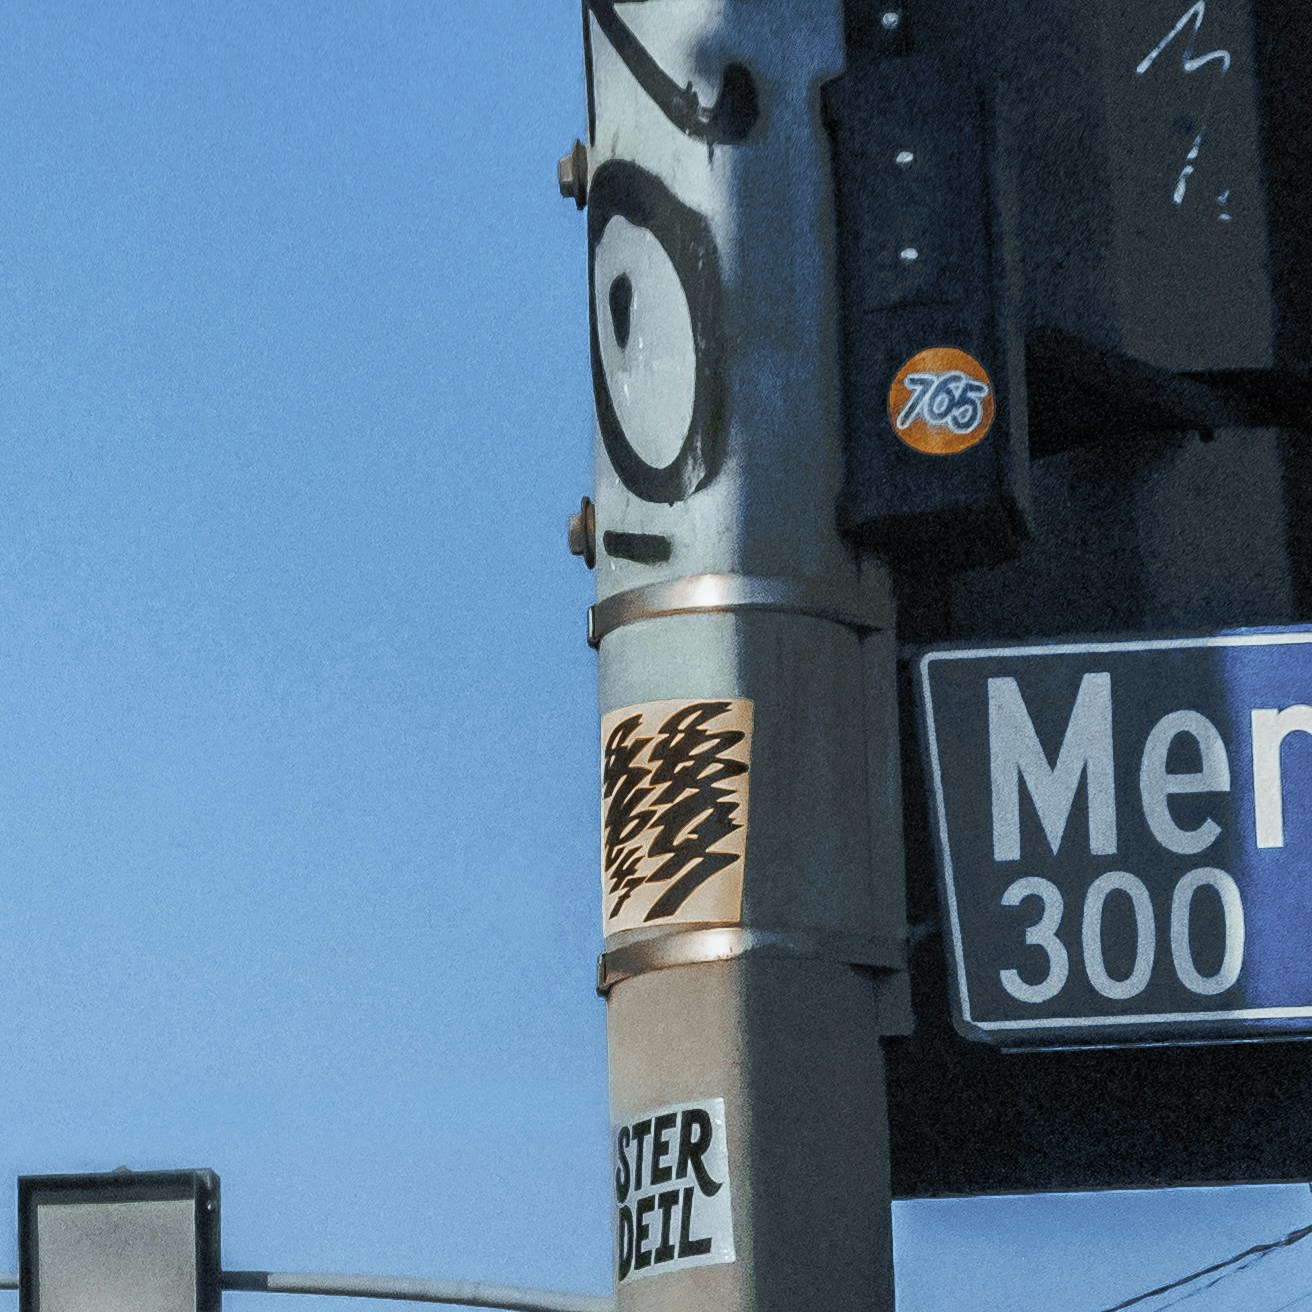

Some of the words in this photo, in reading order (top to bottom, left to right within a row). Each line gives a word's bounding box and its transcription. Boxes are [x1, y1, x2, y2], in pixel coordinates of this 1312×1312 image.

[897, 369, 989, 434] 765
[998, 866, 1246, 1002] 300
[615, 1108, 723, 1204] STER
[618, 1186, 713, 1282] DEIL
